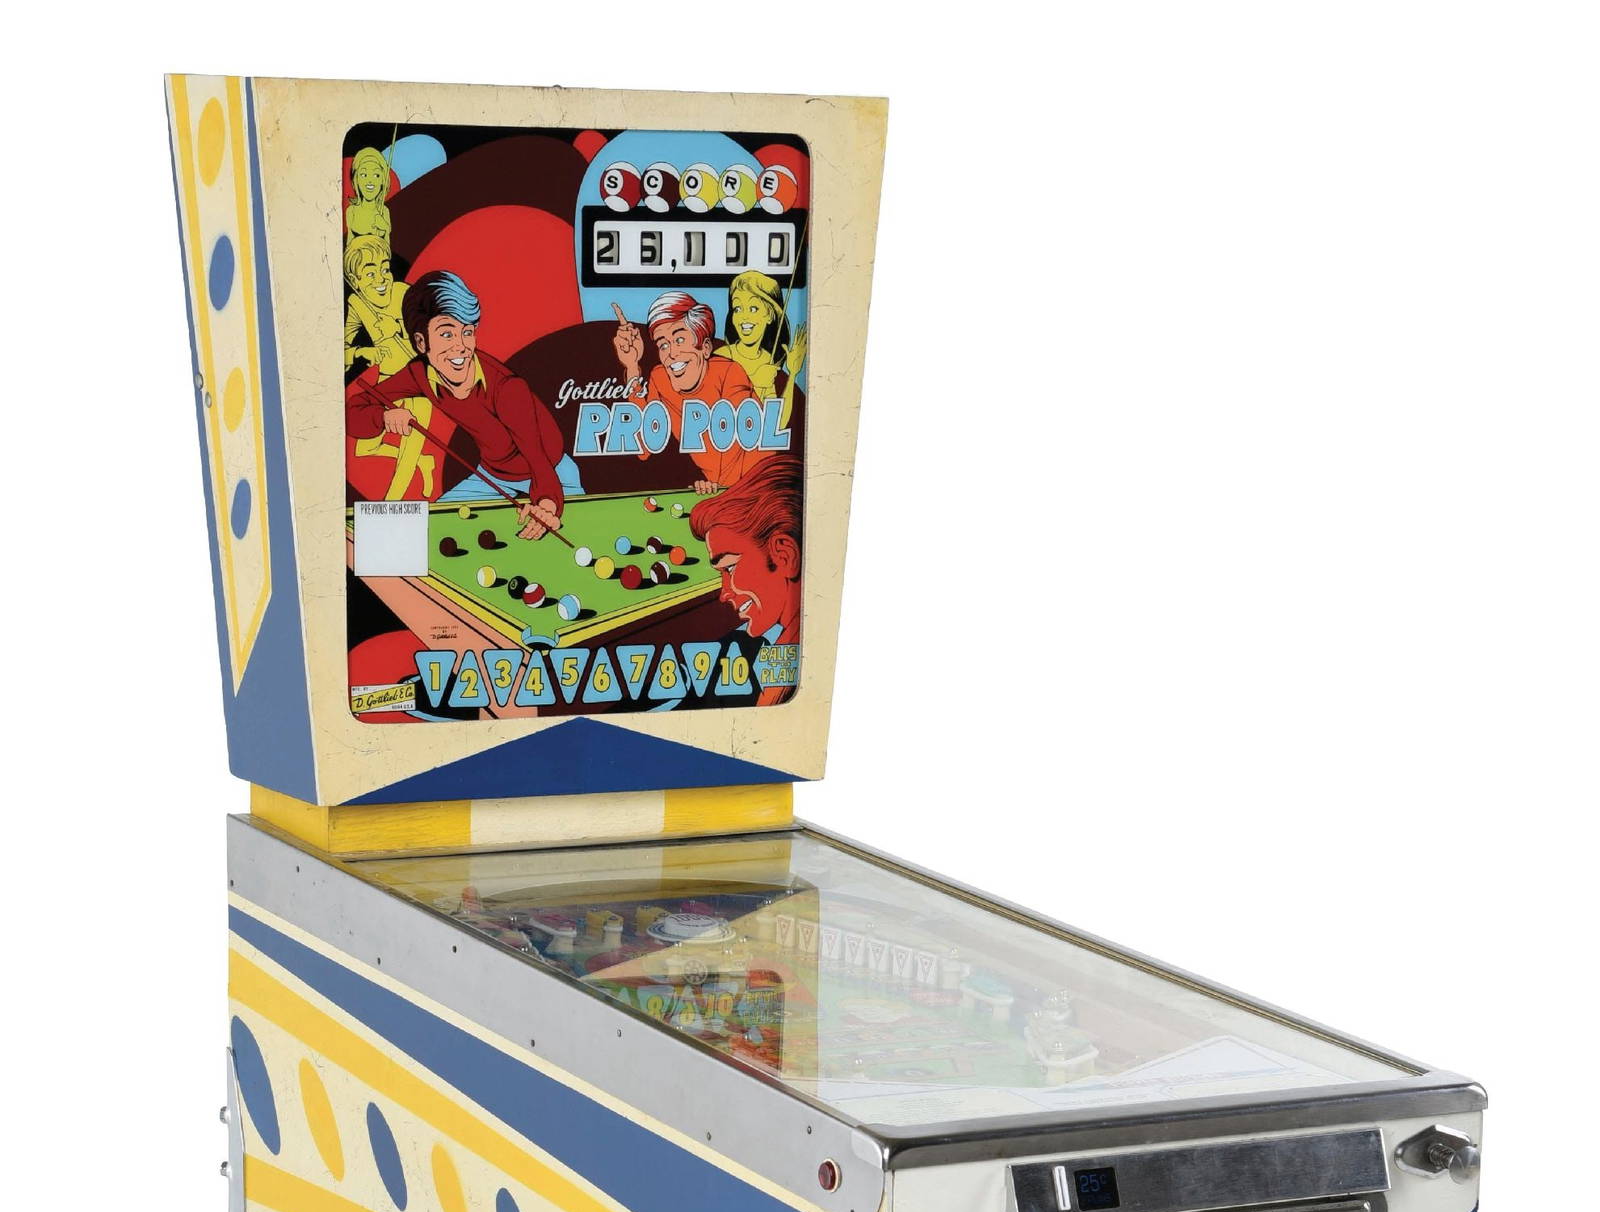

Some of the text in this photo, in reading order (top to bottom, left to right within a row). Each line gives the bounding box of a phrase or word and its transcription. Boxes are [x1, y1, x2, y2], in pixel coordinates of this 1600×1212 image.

[606, 175, 775, 191] SCORE
[555, 376, 649, 408] Gottlieb's
[573, 398, 791, 457] PRO POOL
[360, 503, 421, 514] PREVIOUS HIGH SCORE
[759, 645, 797, 662] BALLS
[429, 651, 750, 698] 1 2 3 4 5 6 7 8 9 10
[760, 668, 797, 684] PLAY
